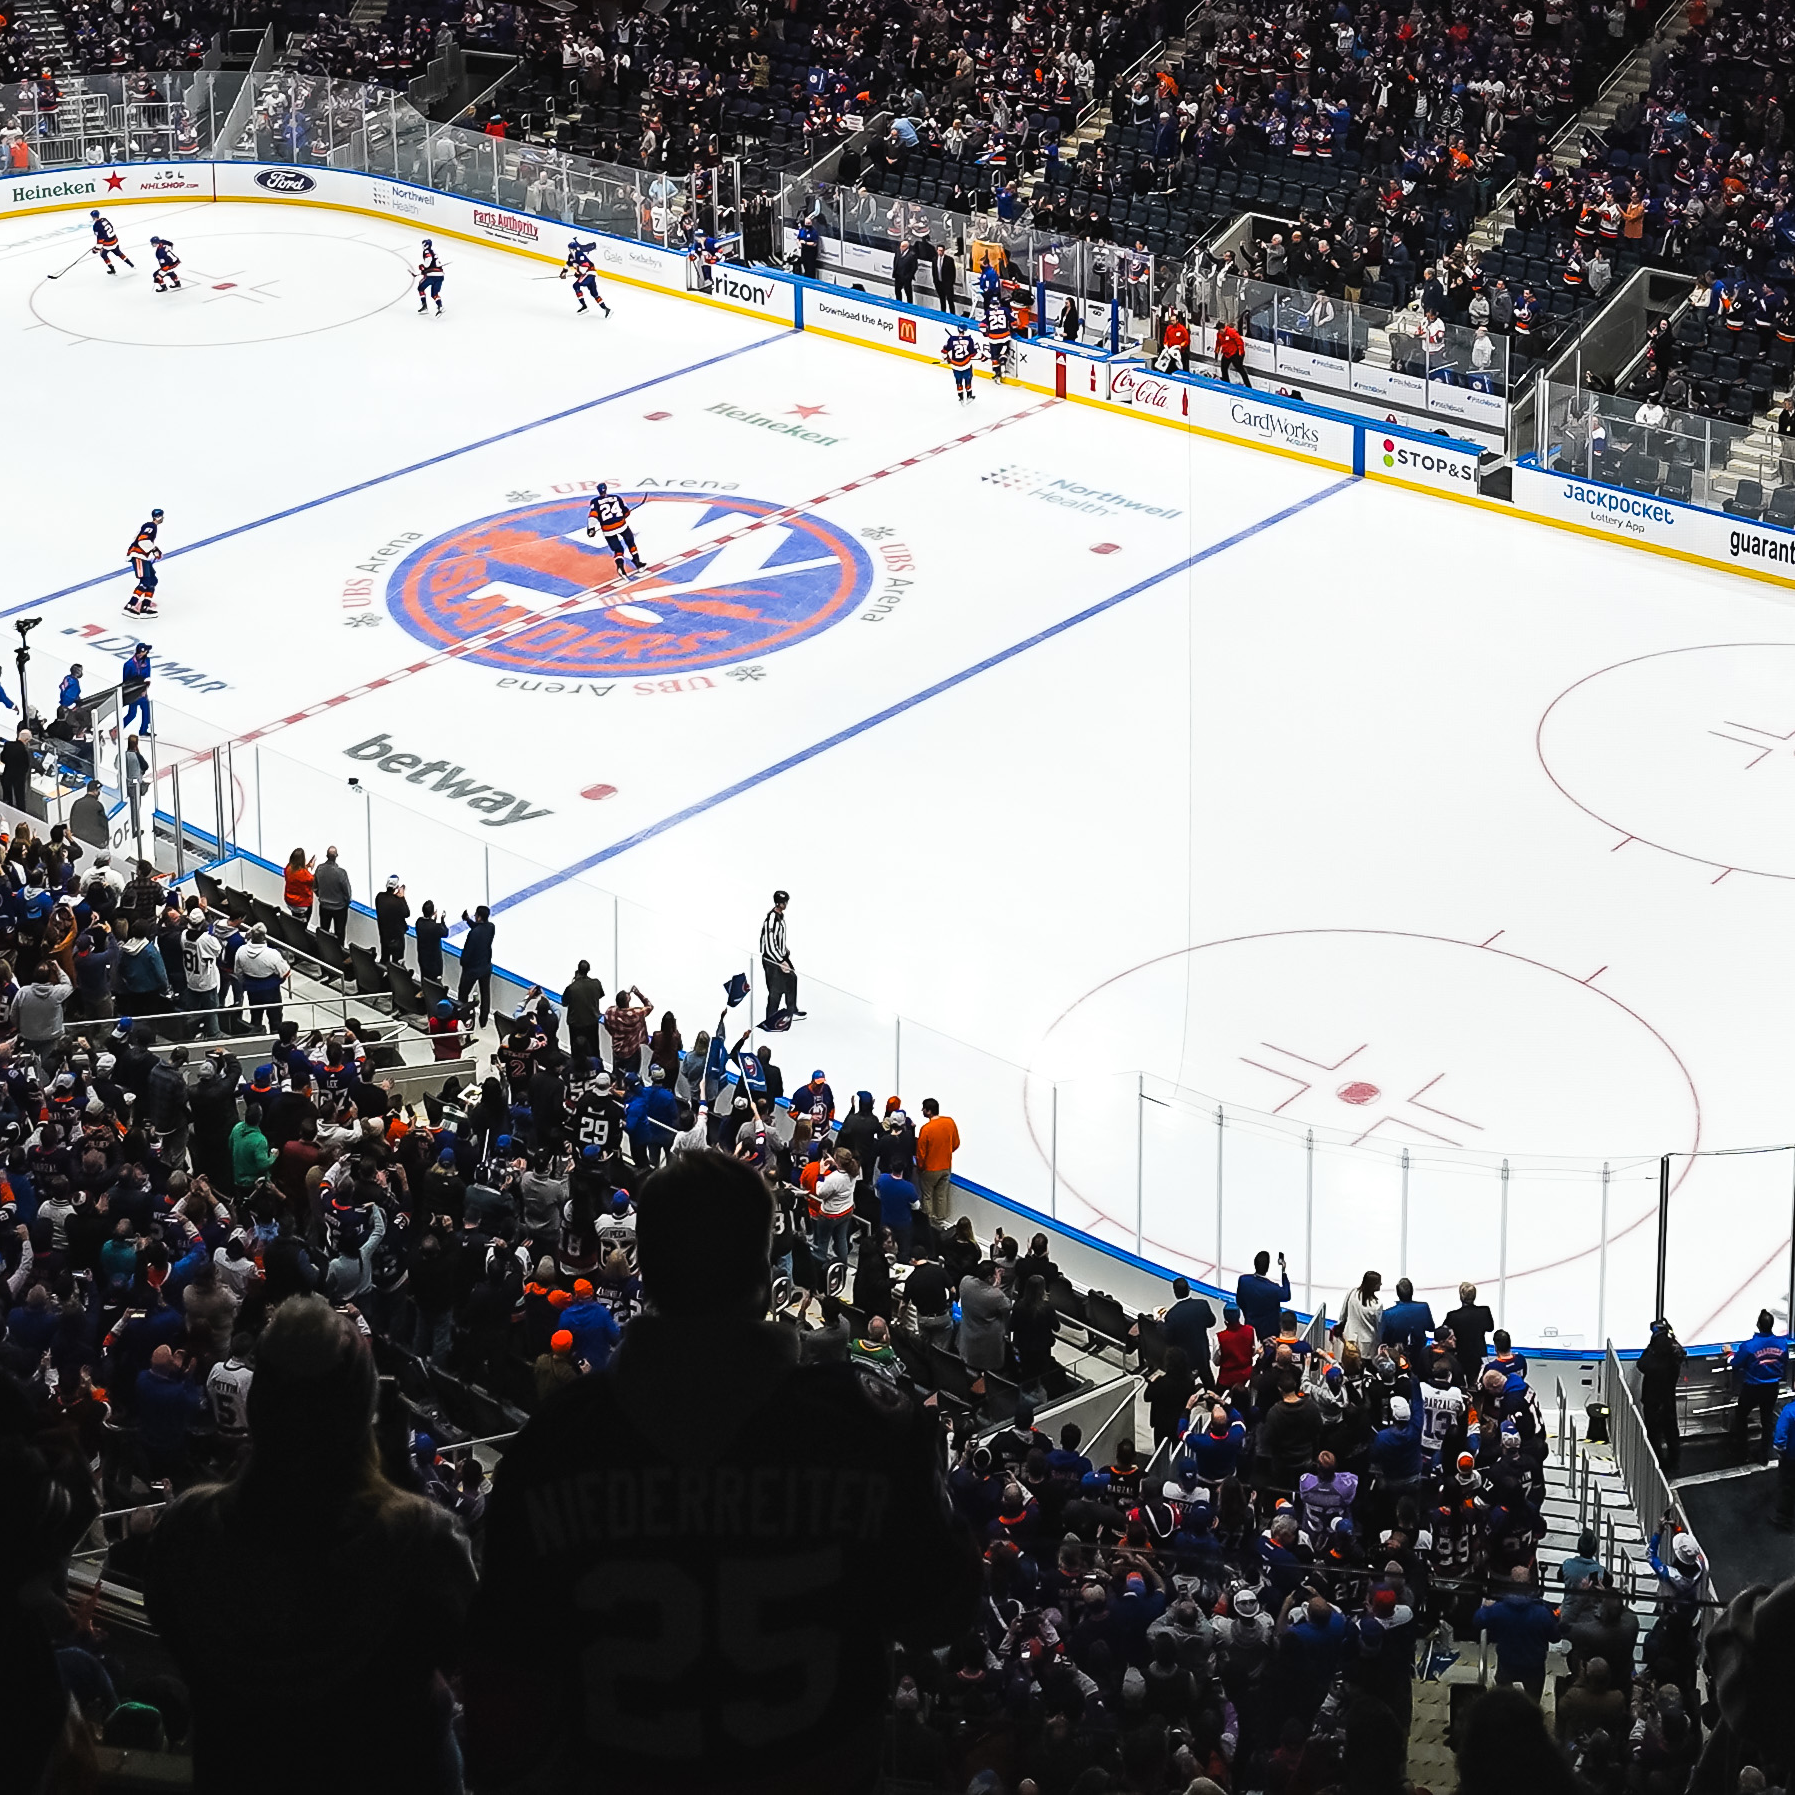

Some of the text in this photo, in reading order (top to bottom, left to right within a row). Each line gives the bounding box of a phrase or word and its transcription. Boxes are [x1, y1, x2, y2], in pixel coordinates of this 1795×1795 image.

[12, 180, 94, 203] Heineken
[267, 171, 304, 191] Ford
[392, 186, 435, 206] Northwell
[473, 209, 539, 236] Parts Authority
[819, 302, 894, 332] Download the App
[989, 315, 1006, 330] 29
[704, 402, 842, 447] Heineken
[1231, 402, 1319, 443] CardWorks
[636, 477, 739, 491] Arena
[599, 502, 623, 520] 24
[1027, 487, 1111, 517] Health
[1047, 478, 1182, 521] Northwell
[1590, 511, 1645, 533] Lottery App
[342, 531, 423, 609] UBS Arena
[860, 543, 915, 622] UBS Arena
[496, 676, 718, 697] UBS Arena
[342, 733, 556, 826] betway
[183, 949, 202, 975] 81
[580, 1117, 609, 1145] 29
